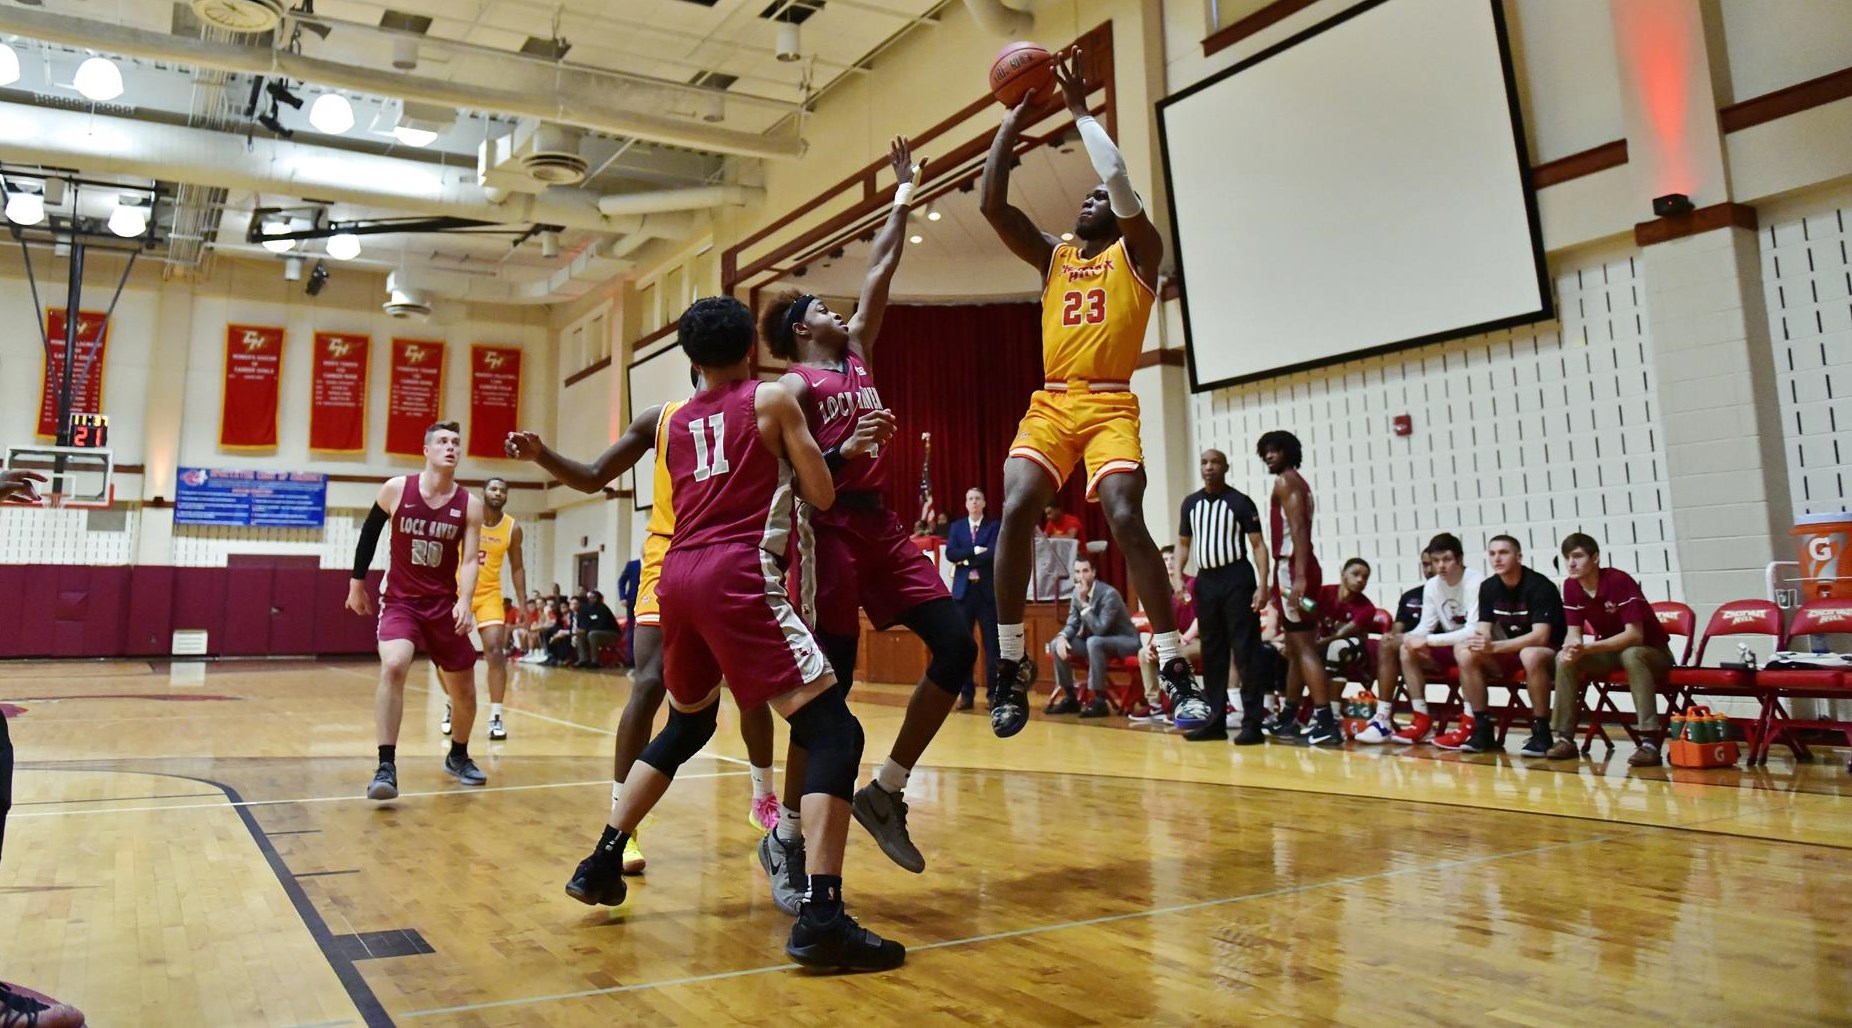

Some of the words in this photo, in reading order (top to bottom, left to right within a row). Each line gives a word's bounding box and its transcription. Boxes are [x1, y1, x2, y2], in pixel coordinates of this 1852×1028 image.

[1062, 289, 1106, 327] 23
[74, 426, 103, 448] 21
[688, 411, 730, 483] 11
[399, 516, 426, 536] LOCK
[411, 538, 444, 568] 20
[1809, 537, 1832, 561] G
[1714, 746, 1725, 762] G
